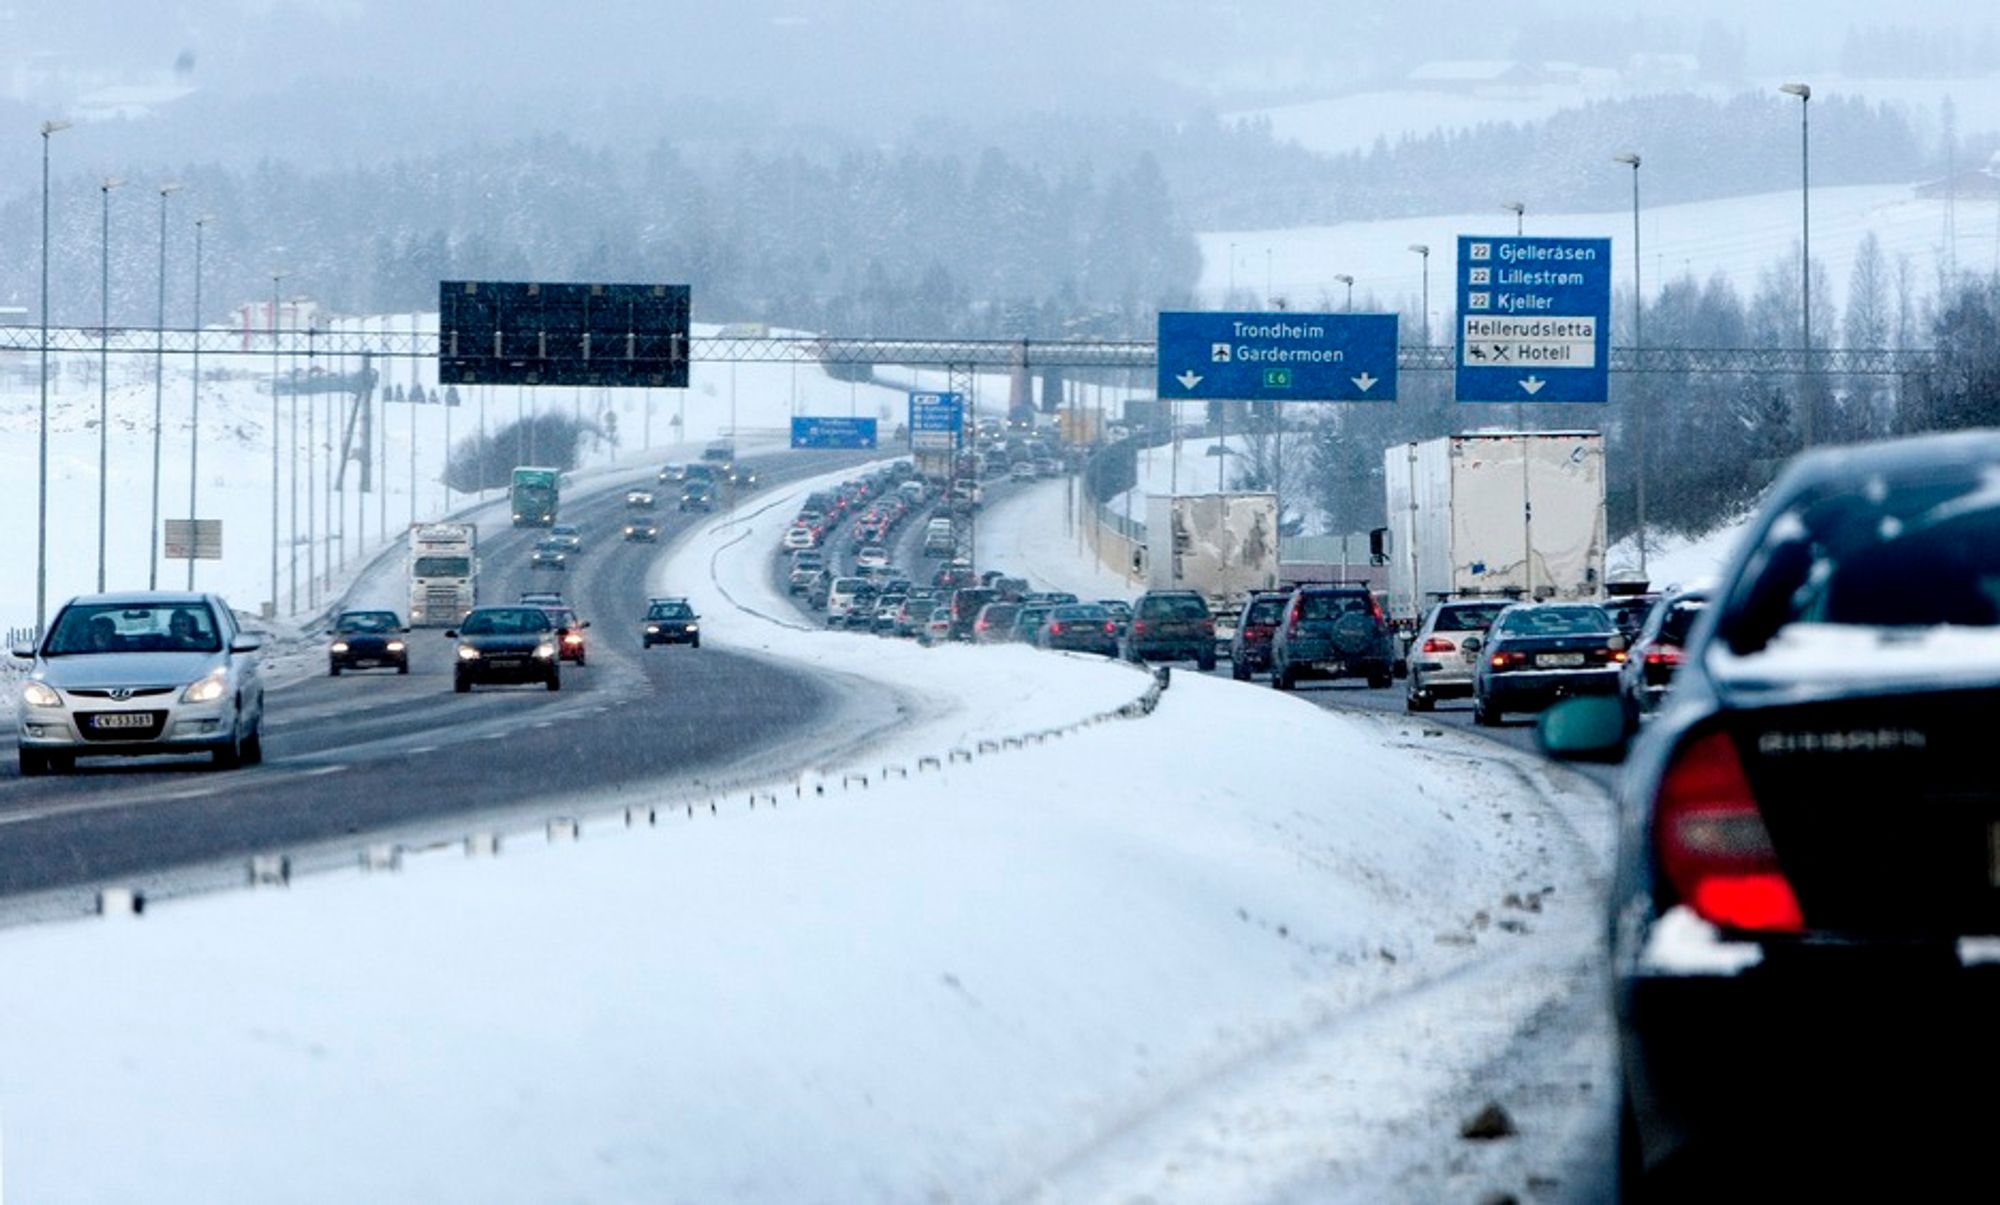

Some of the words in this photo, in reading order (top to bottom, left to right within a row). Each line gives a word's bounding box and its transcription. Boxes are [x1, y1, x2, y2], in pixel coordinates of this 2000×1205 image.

[1473, 246, 1487, 257] 22
[1499, 243, 1595, 263] Gjelleråsen
[1472, 271, 1487, 281] 22
[1499, 269, 1584, 285] Lillestrøm
[1472, 295, 1486, 305] 22
[1498, 293, 1553, 312] Kjeller
[1233, 322, 1324, 338] Trondheim
[1467, 321, 1592, 337] Hellerudsletta
[1237, 346, 1344, 362] Gardermoen
[1519, 345, 1570, 360] Hotell
